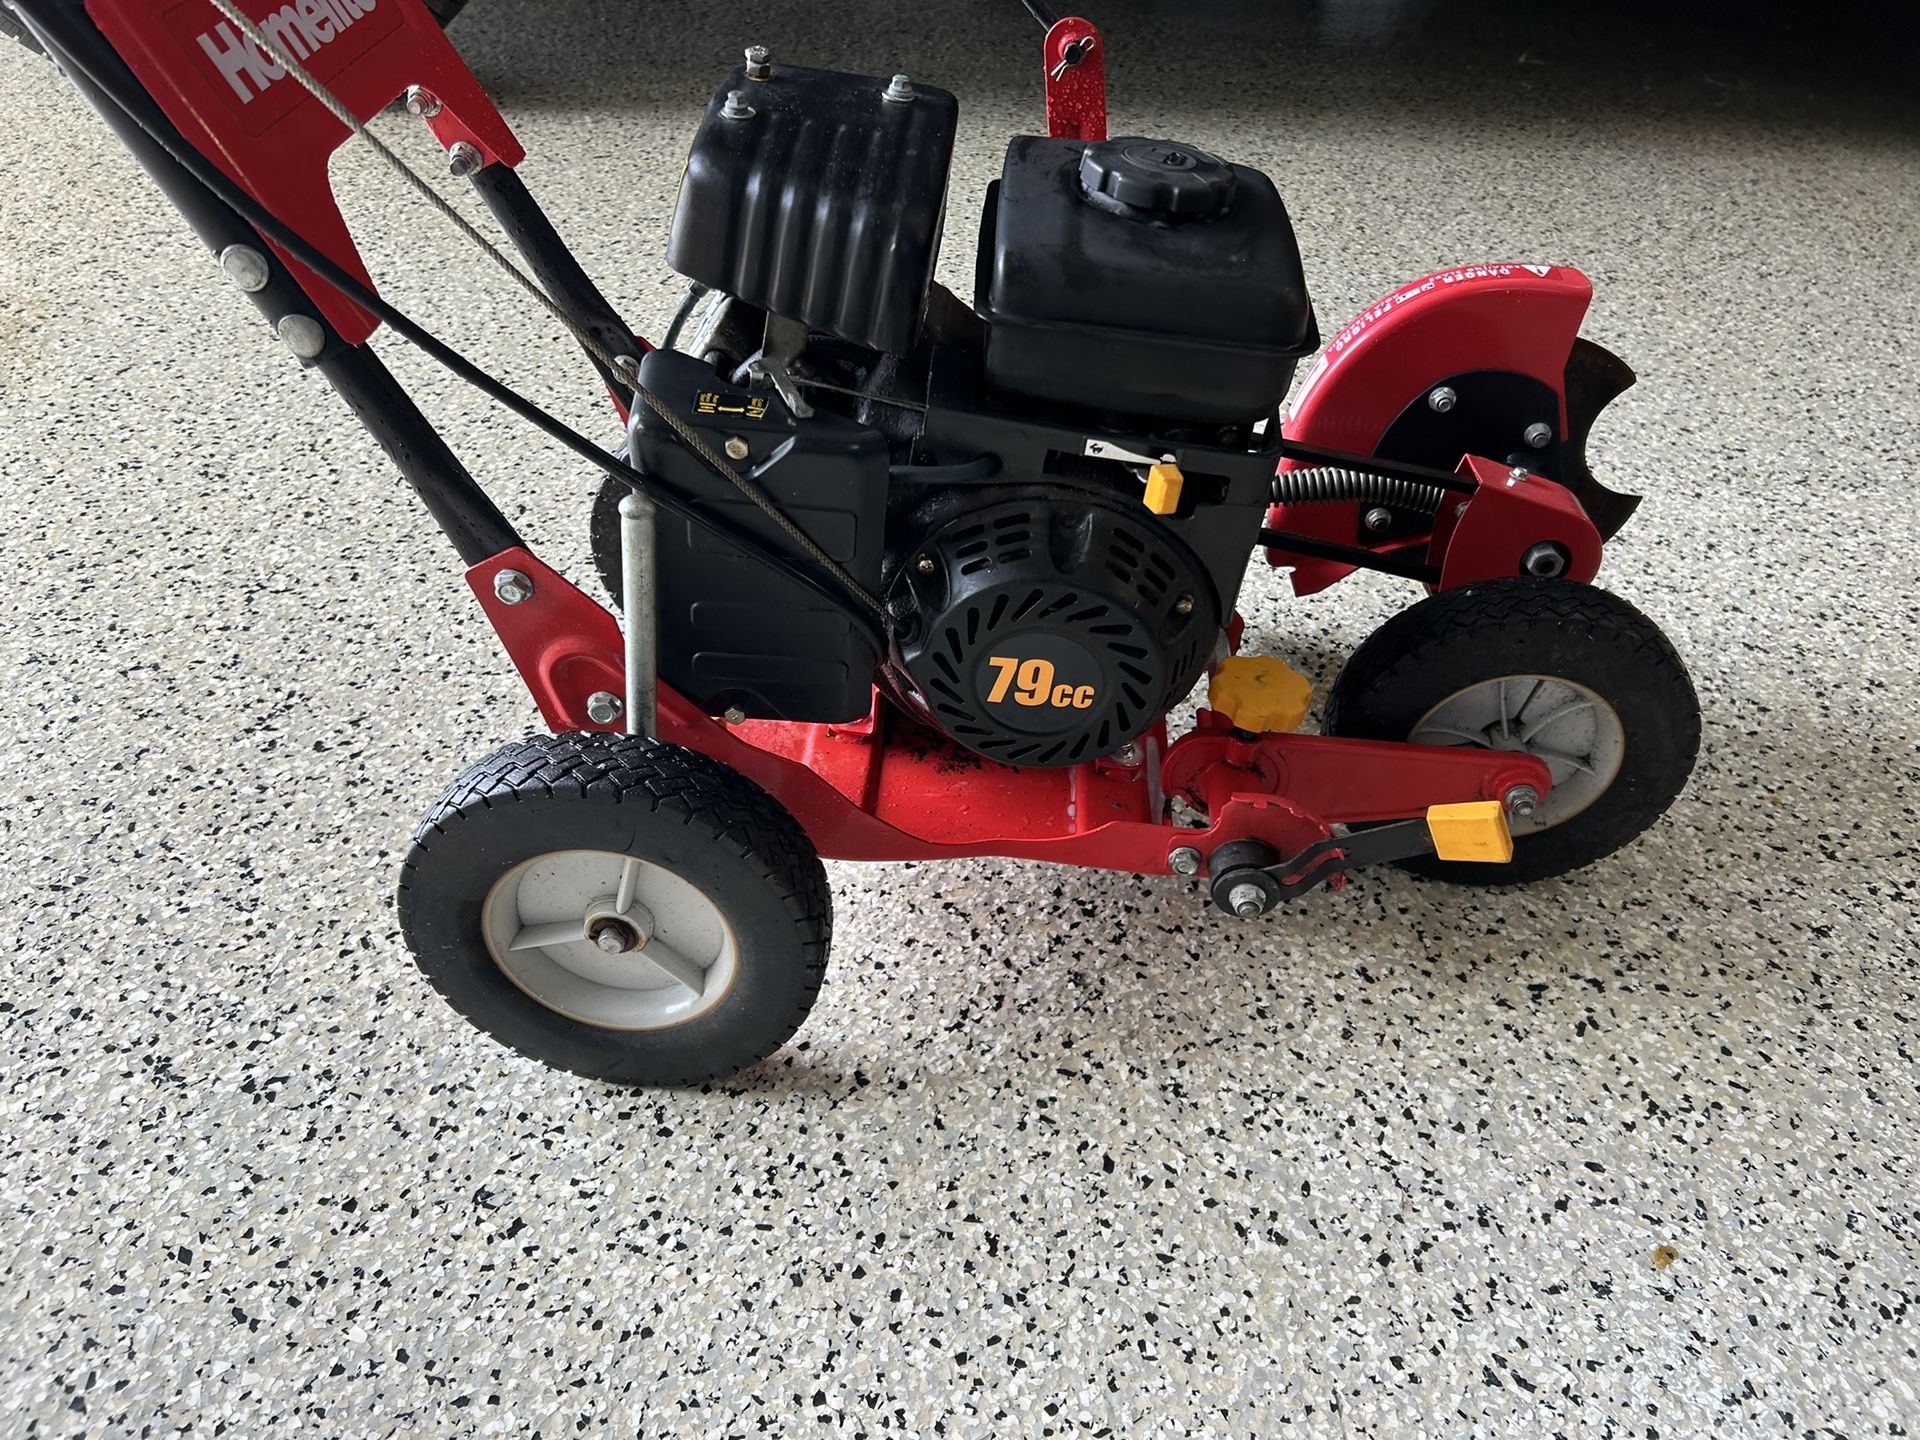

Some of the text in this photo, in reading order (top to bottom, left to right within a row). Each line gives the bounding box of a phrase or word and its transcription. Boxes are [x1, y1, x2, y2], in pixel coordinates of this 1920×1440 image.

[196, 0, 376, 104] Homeli
[1442, 267, 1510, 284] DANGER
[1335, 302, 1392, 351] PELIGRO
[987, 656, 1095, 708] 79cc
